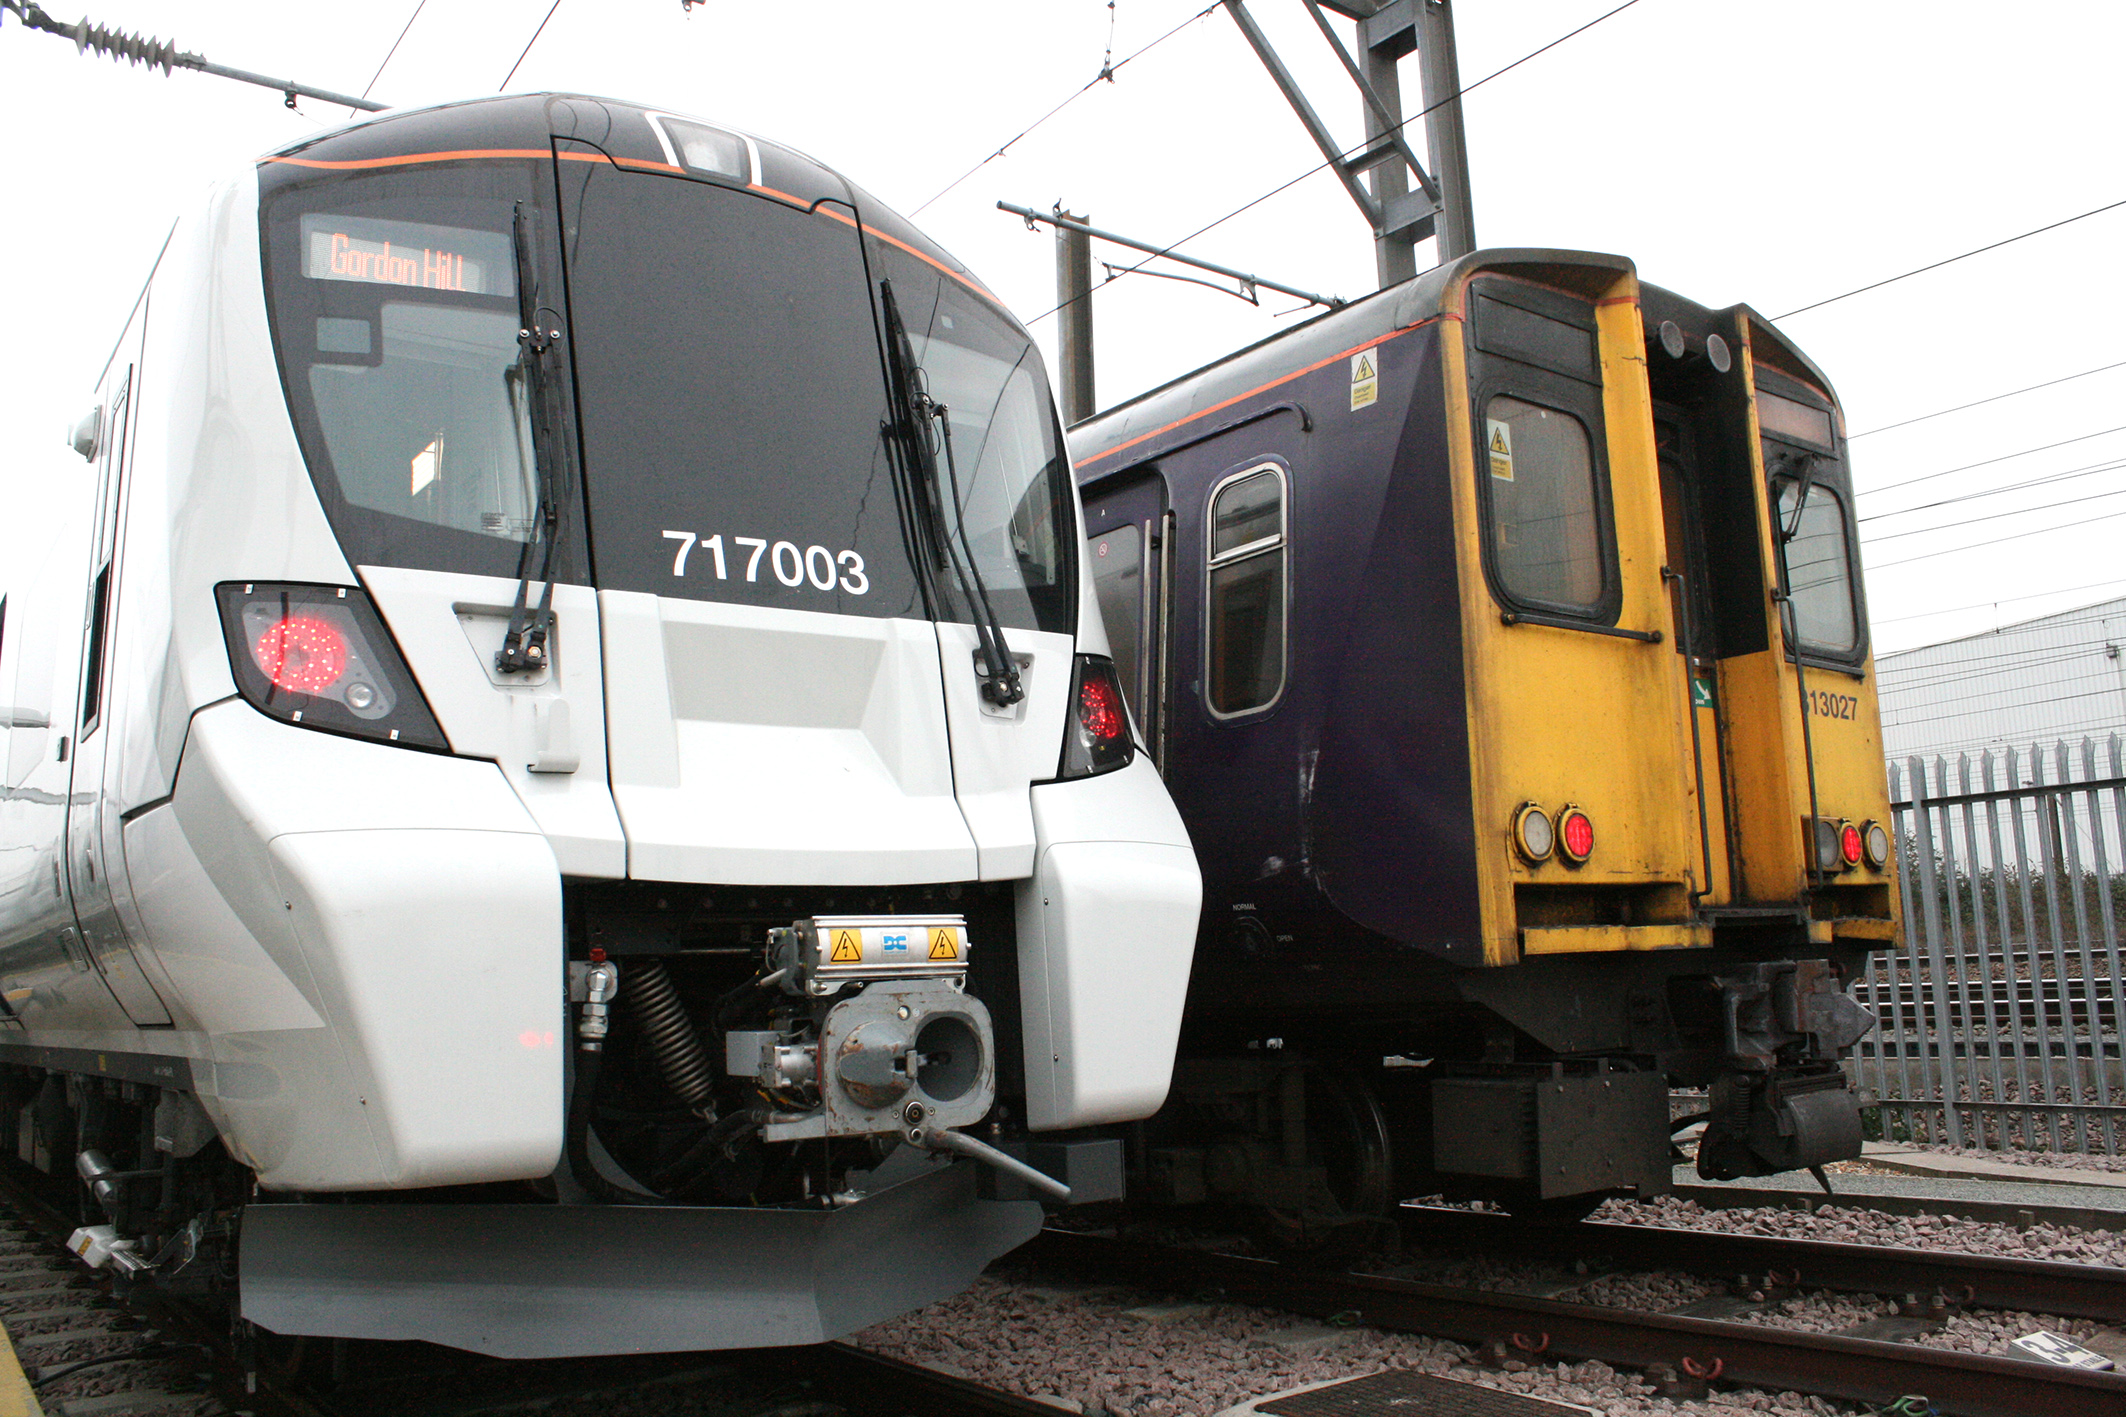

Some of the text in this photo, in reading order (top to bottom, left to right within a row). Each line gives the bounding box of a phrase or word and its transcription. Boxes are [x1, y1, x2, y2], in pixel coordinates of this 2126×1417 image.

[331, 233, 466, 291] Gordon Hill
[662, 530, 869, 595] 717003
[1232, 903, 1257, 911] NORMAL
[1276, 934, 1294, 942] OPEN
[2021, 1333, 2089, 1364] 3-4
